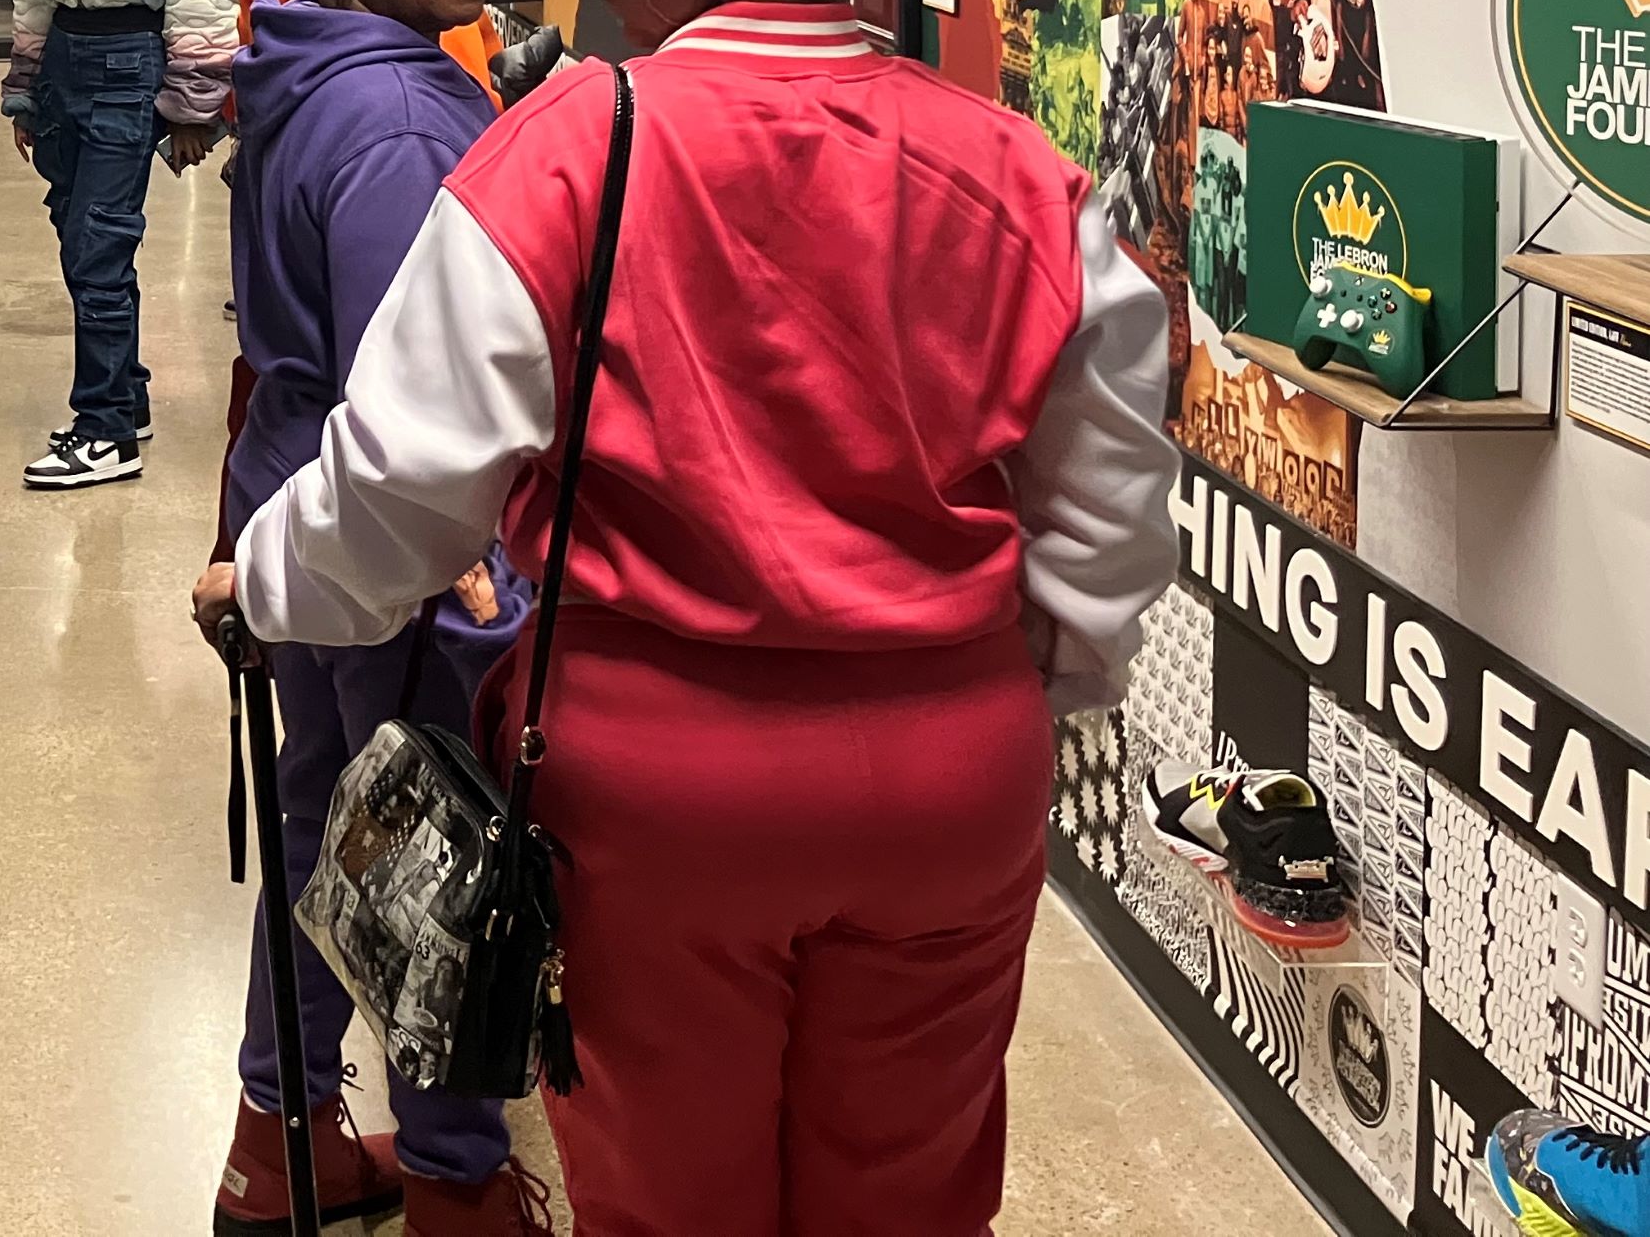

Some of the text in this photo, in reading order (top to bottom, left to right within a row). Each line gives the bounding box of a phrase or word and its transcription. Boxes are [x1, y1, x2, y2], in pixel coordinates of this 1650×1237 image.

[1571, 25, 1647, 67] THE
[1311, 236, 1336, 262] THE
[1337, 243, 1389, 273] LEBRON
[1364, 591, 1448, 752] IS
[1429, 1077, 1476, 1160] WE
